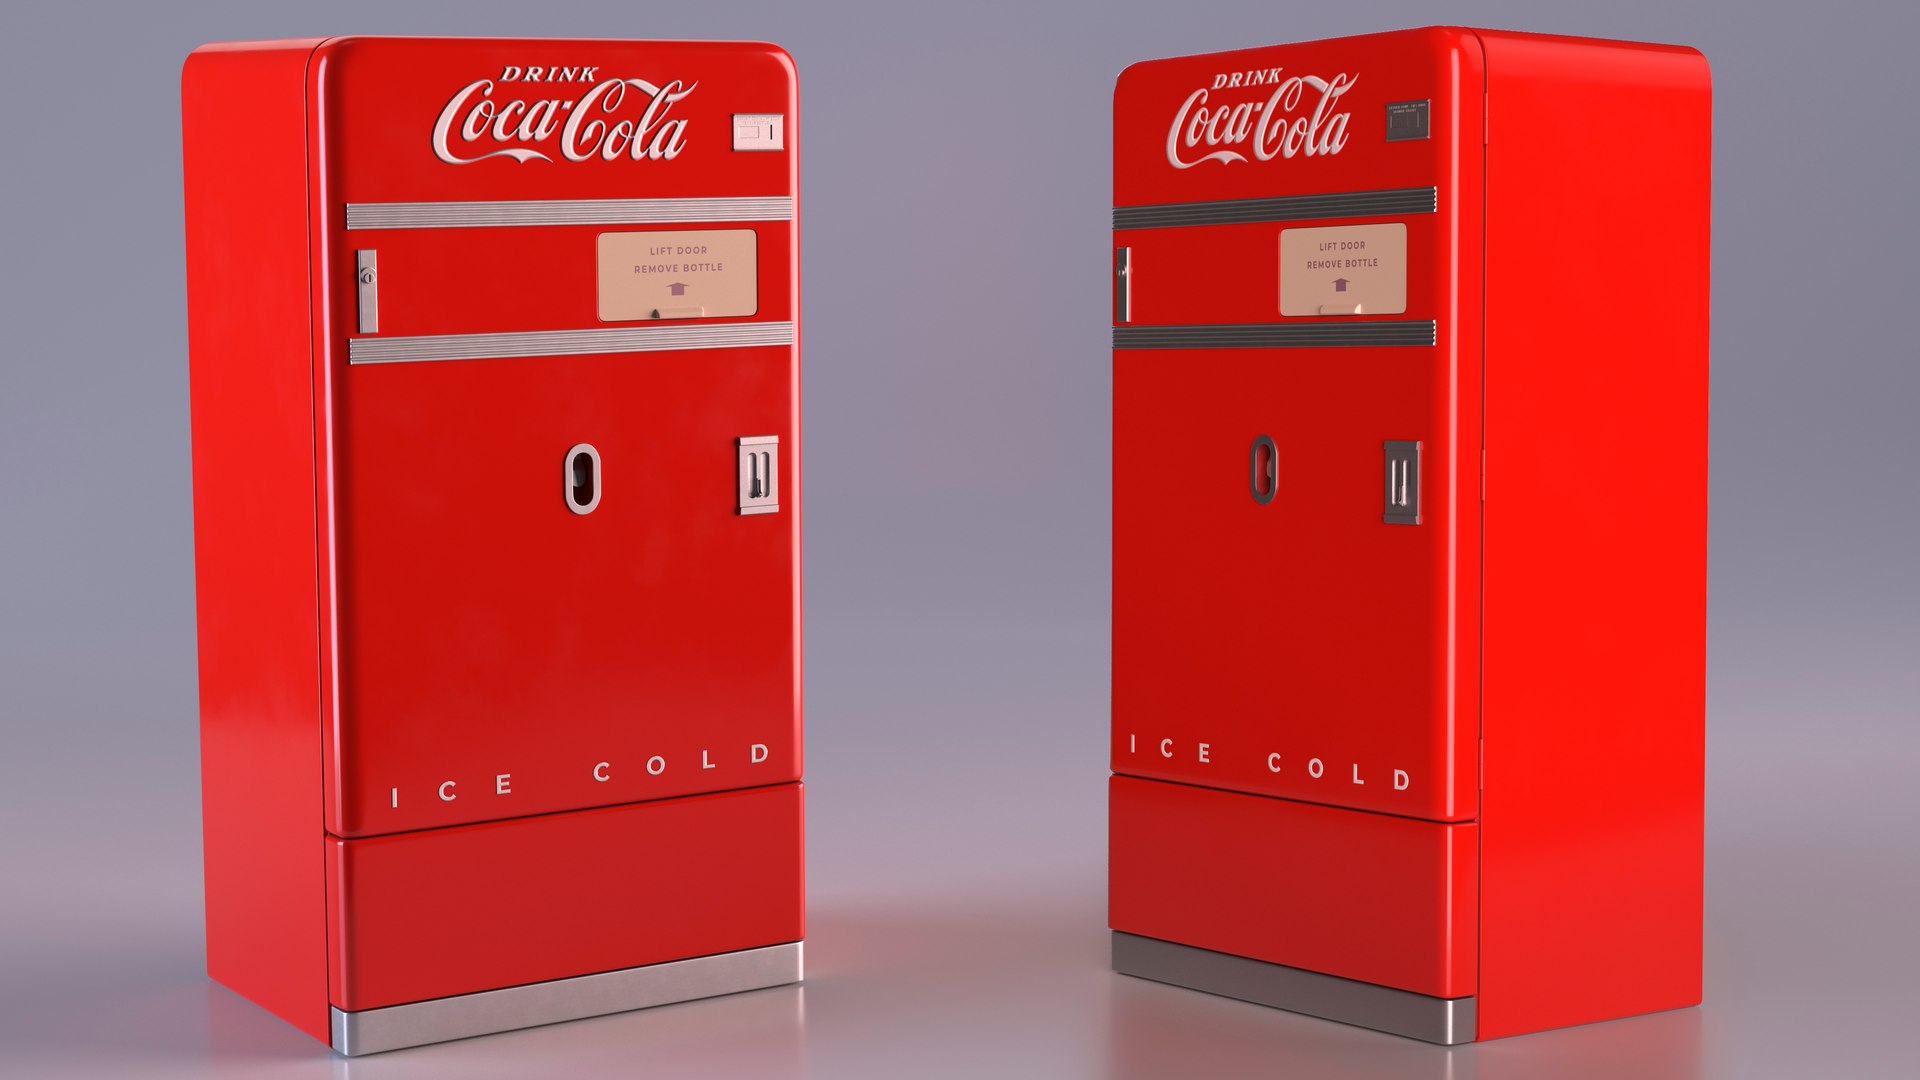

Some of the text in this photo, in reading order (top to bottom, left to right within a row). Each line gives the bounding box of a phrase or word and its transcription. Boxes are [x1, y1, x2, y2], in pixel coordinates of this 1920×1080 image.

[497, 65, 600, 83] DRINK
[1211, 67, 1284, 90] DRINK
[431, 78, 699, 165] Coca-Cola
[1166, 72, 1360, 169] Coca-Cola
[649, 246, 707, 256] LIFT DOOR
[1319, 240, 1366, 251] LIFT DOOR
[634, 262, 723, 274] REMOVE BOTTLE
[1306, 258, 1378, 270] REMOVE BOTTLE
[1130, 734, 1410, 791] ICE COLD
[390, 743, 769, 808] ICE COLD
